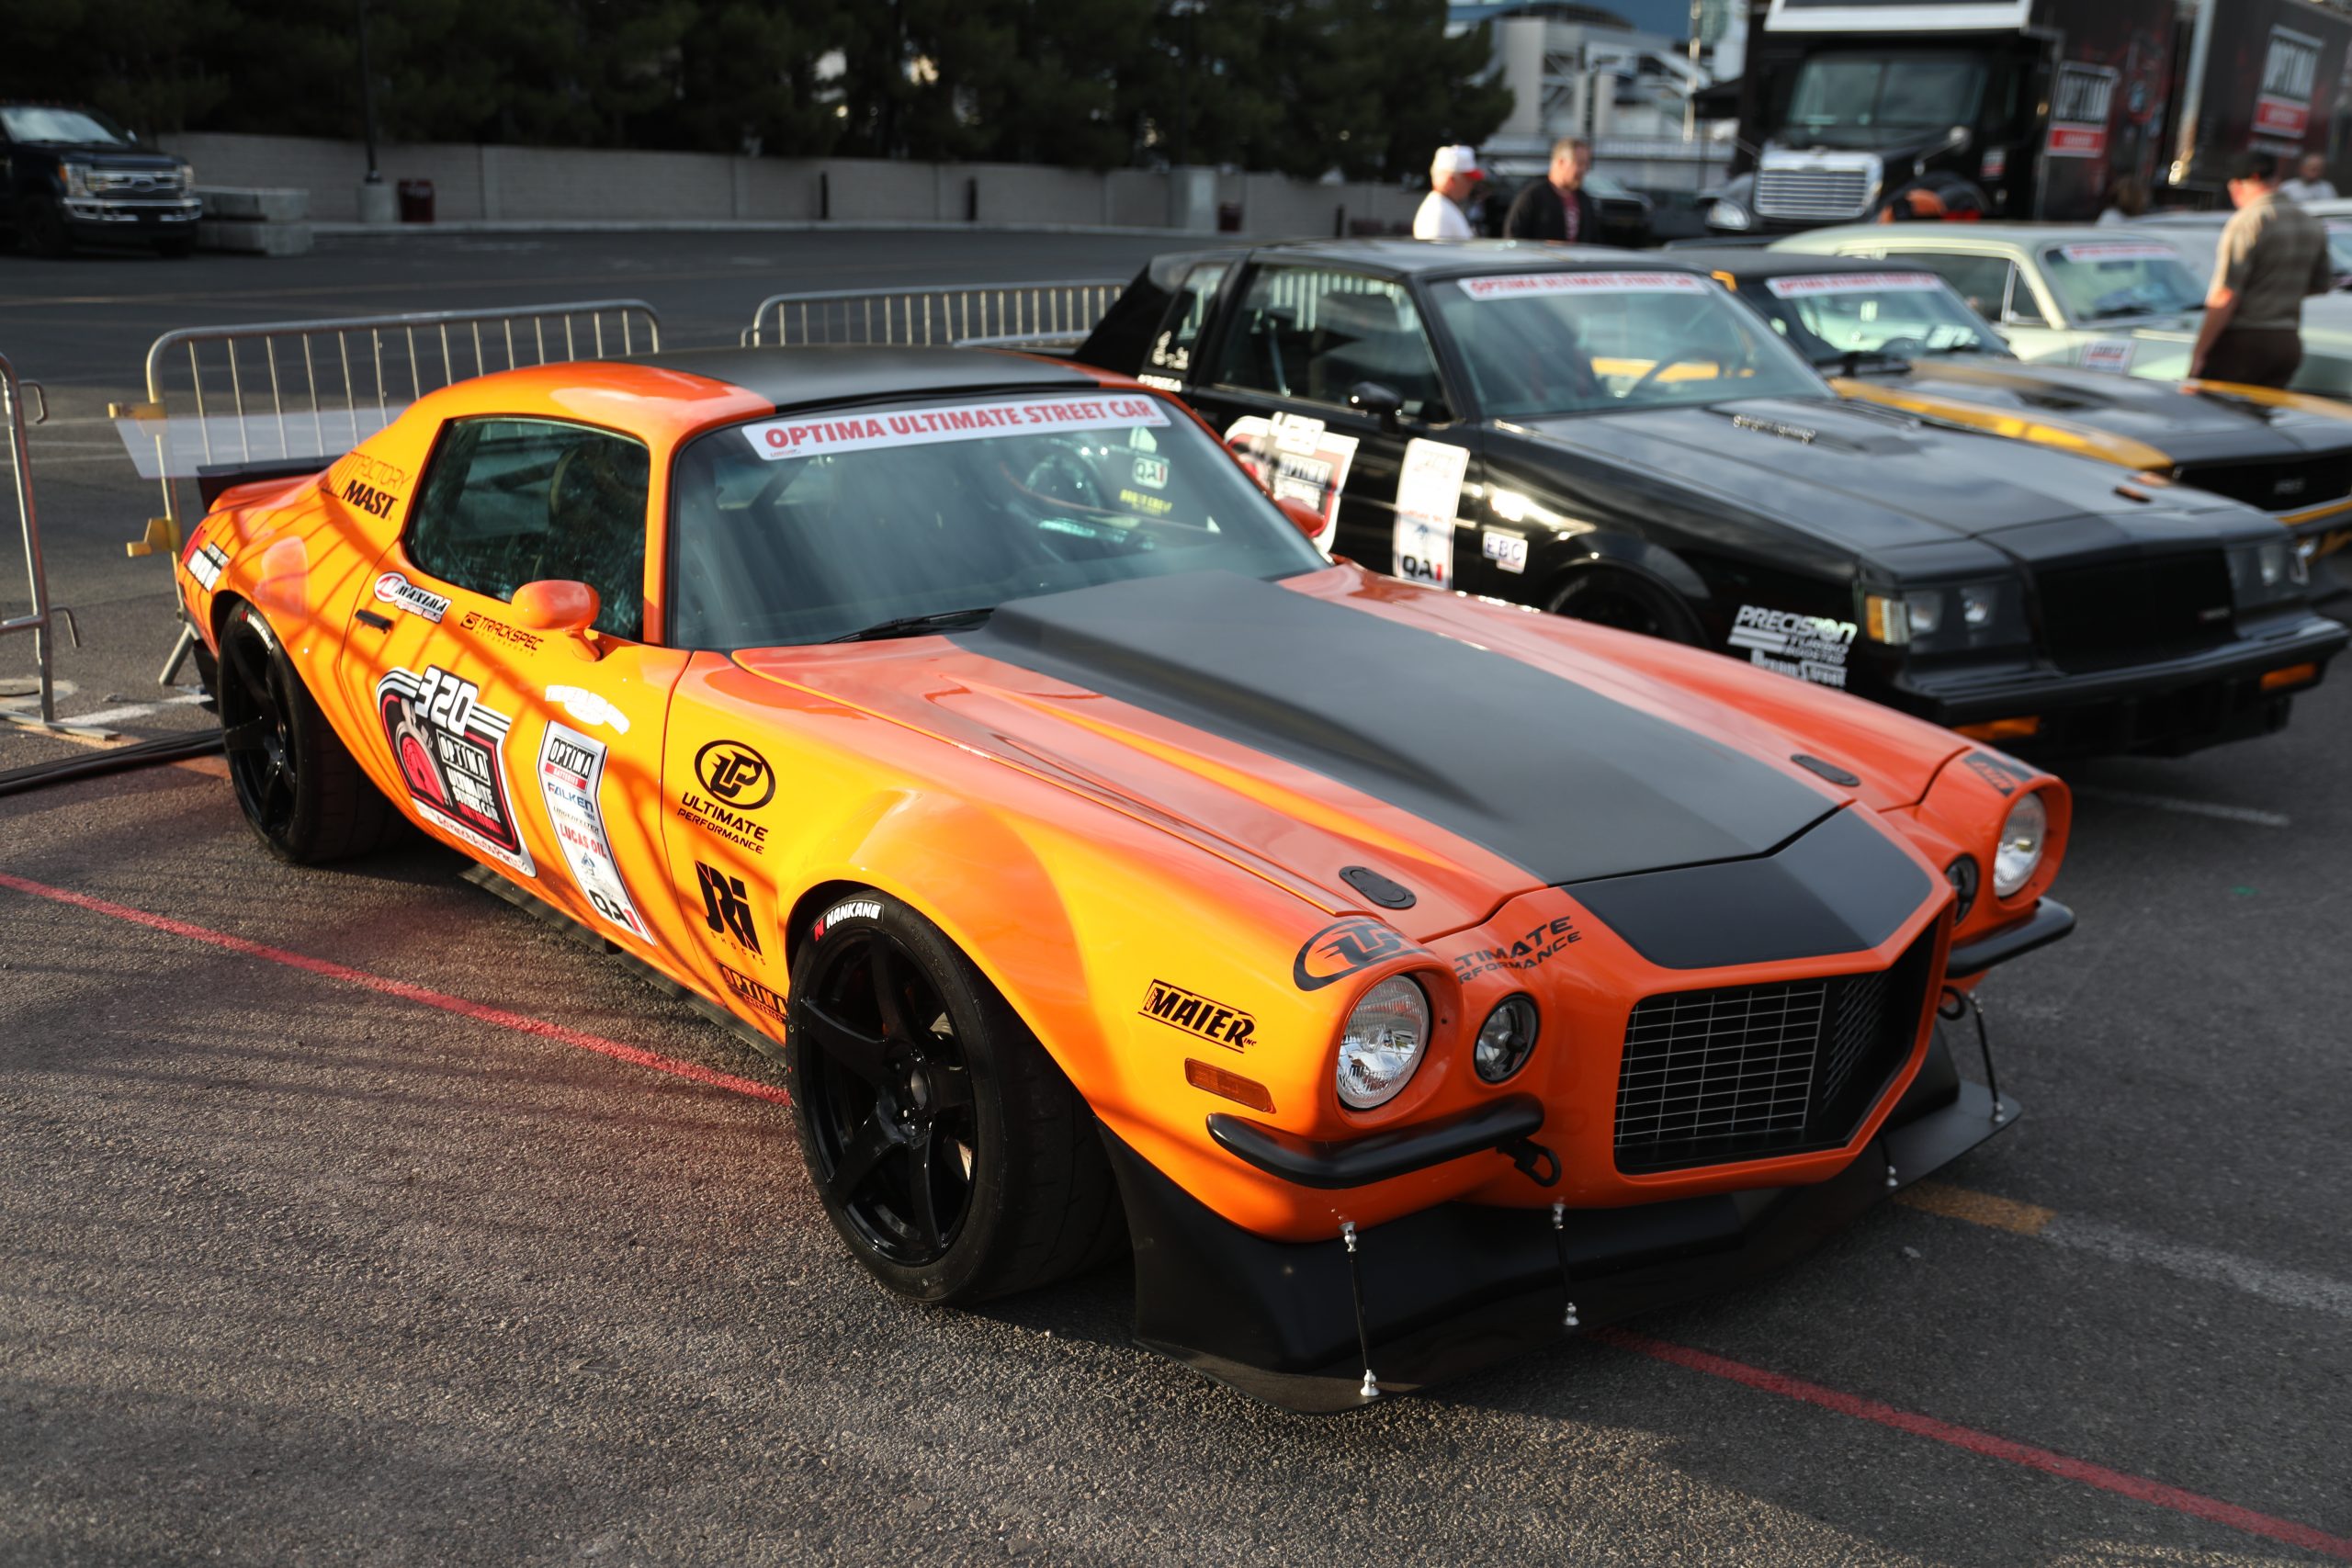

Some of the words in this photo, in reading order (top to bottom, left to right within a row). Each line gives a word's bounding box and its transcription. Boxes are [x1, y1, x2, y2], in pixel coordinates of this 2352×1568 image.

[764, 418, 887, 448] OPTIMA
[888, 406, 1023, 435] ULTIMATE
[1023, 400, 1108, 423] STREET
[1108, 400, 1156, 419] CAR
[341, 479, 399, 519] MAST
[1403, 555, 1442, 582] QA1
[1487, 536, 1523, 561] EBC
[394, 583, 448, 614] MAXIMA
[478, 616, 545, 651] TRACKSPEC
[414, 666, 479, 736] 320
[438, 735, 490, 781] OPTIMA
[549, 739, 593, 777] OPTIMA
[446, 766, 496, 807] ULTIMATE
[547, 782, 594, 814] FALKEN
[677, 807, 764, 855] PERFORMANCE
[682, 791, 769, 842] ULTIMATE
[560, 822, 590, 851] LUCAS
[590, 839, 608, 859] OIL
[589, 888, 641, 933] QA1
[826, 901, 882, 931] NANKANG
[1453, 915, 1573, 972] LTIMATE
[721, 965, 787, 1016] OPTIMA
[1151, 987, 1256, 1049] MAIER
